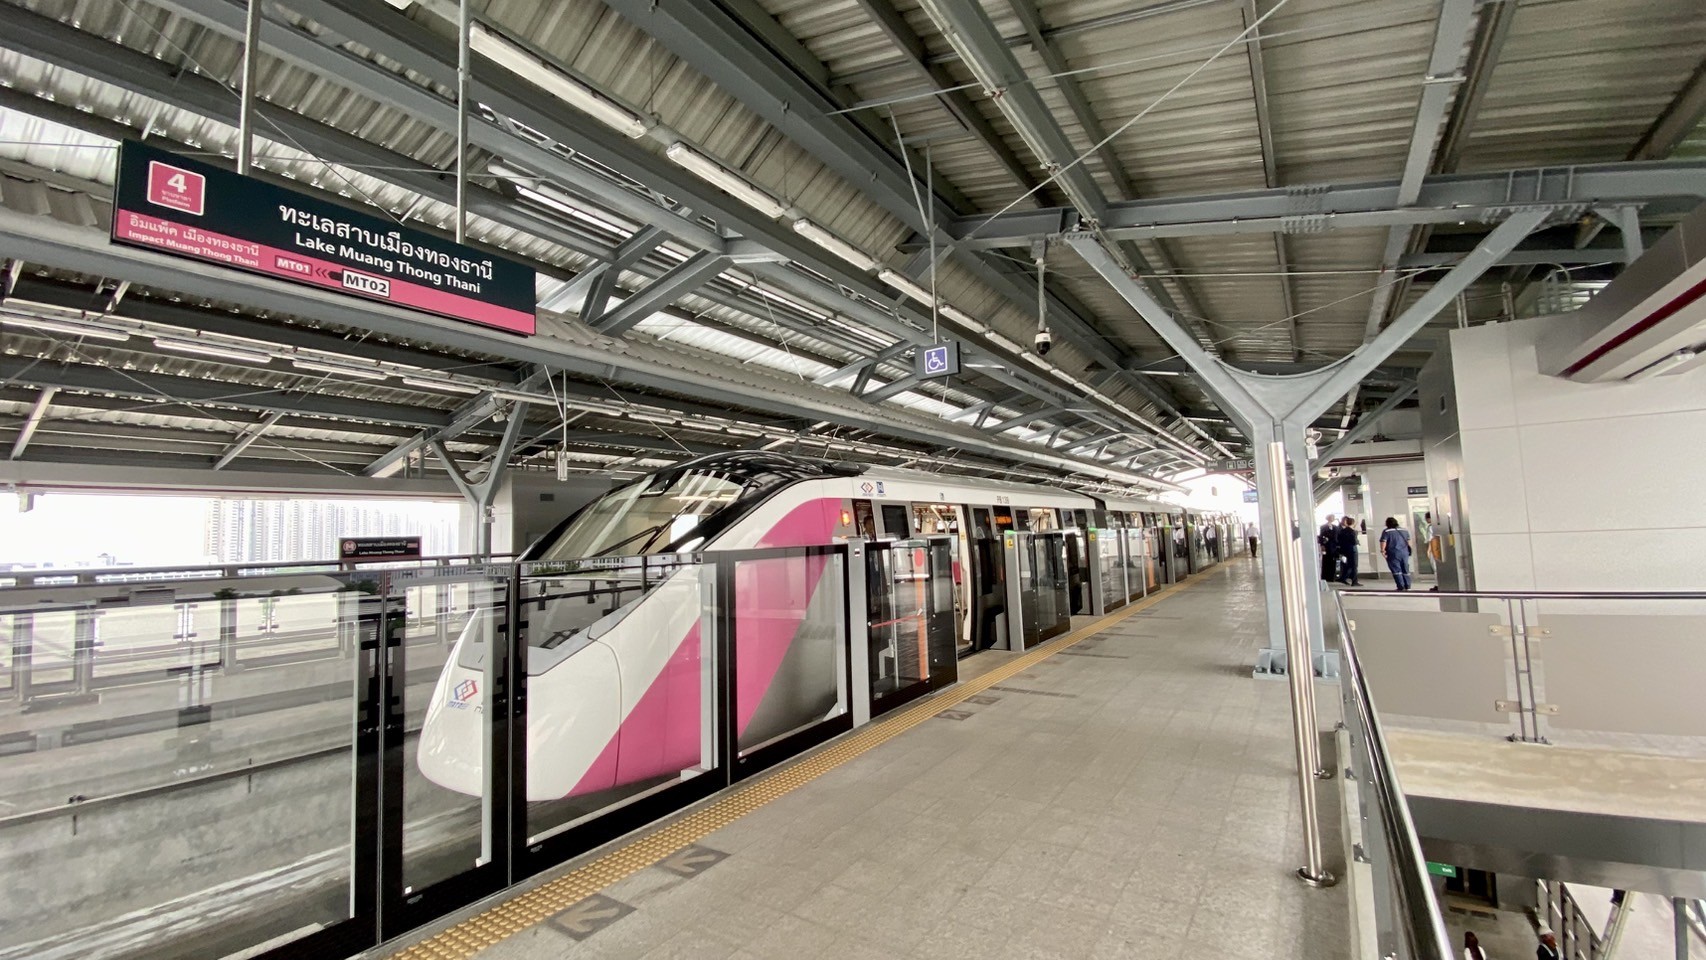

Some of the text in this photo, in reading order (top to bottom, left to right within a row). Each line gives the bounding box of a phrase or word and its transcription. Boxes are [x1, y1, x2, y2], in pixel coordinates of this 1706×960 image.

[167, 173, 188, 194] 4
[128, 230, 259, 267] Impact Muang Thong Thani
[183, 225, 260, 257] เมืองทองธานี
[279, 204, 493, 281] ทะเลสาบเมืองทองธานี
[277, 257, 311, 274] MT01
[295, 232, 481, 294] Lake Muang Thong Thani
[345, 273, 388, 294] MT02
